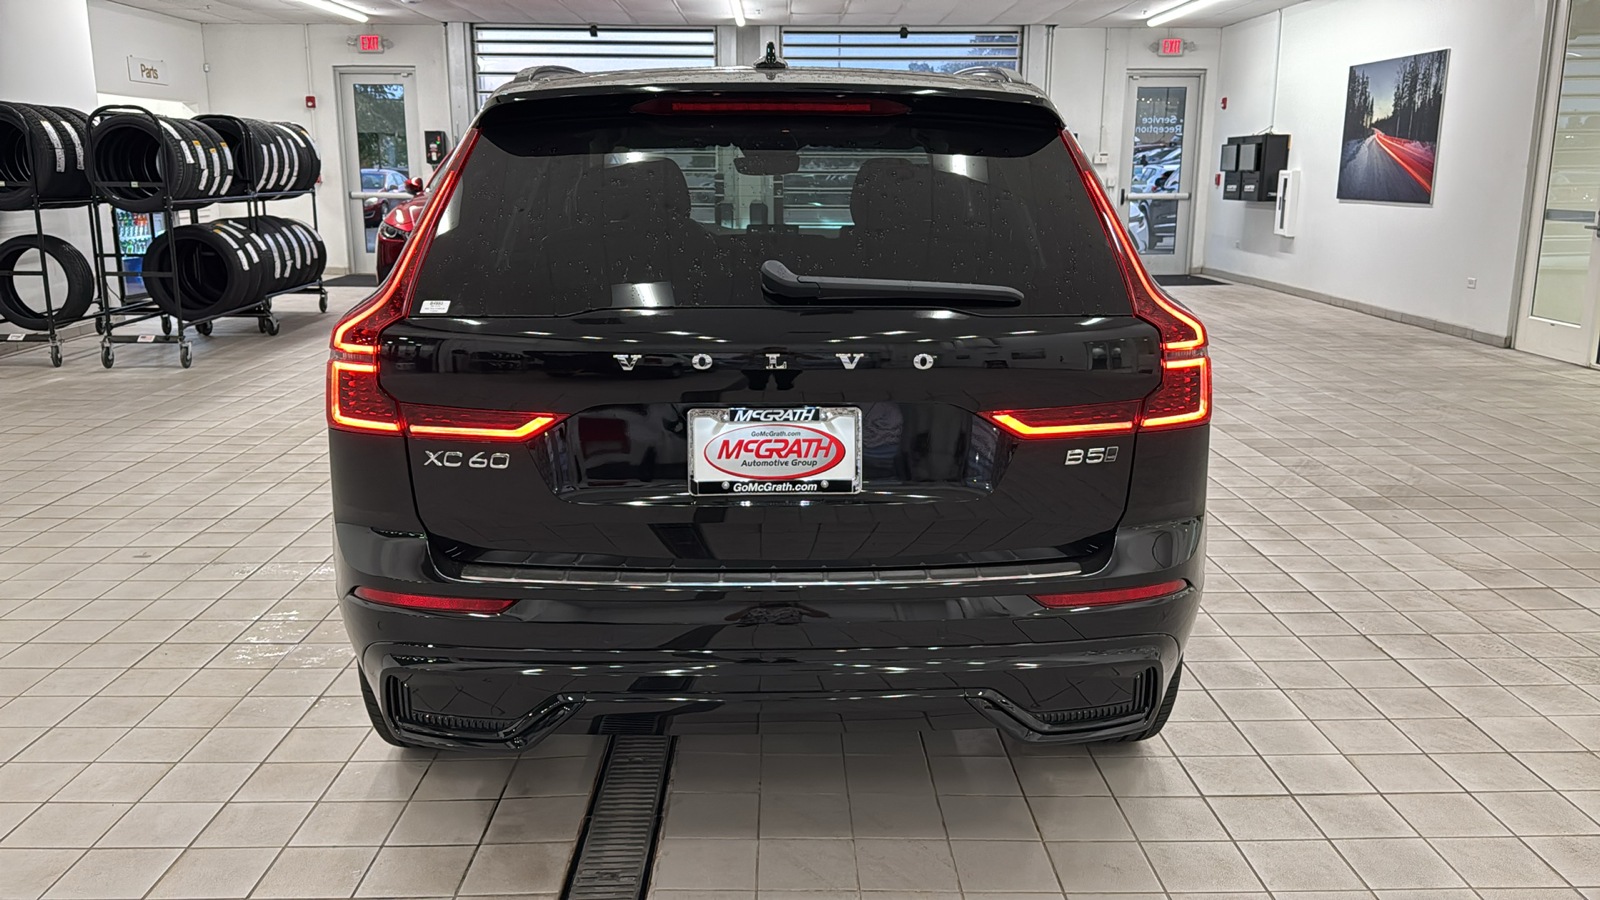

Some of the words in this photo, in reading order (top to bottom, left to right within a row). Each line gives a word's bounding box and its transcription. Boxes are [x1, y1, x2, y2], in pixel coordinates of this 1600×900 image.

[360, 35, 379, 50] EXIT
[1162, 38, 1182, 54] EXIT
[140, 63, 159, 80] Parts
[612, 352, 934, 371] VOLVO
[750, 430, 802, 438] GoMcGrath.com
[740, 459, 789, 467] Automotive
[791, 459, 818, 468] Group
[1064, 447, 1106, 466] B5
[733, 482, 818, 493] GoMcGrath.com
